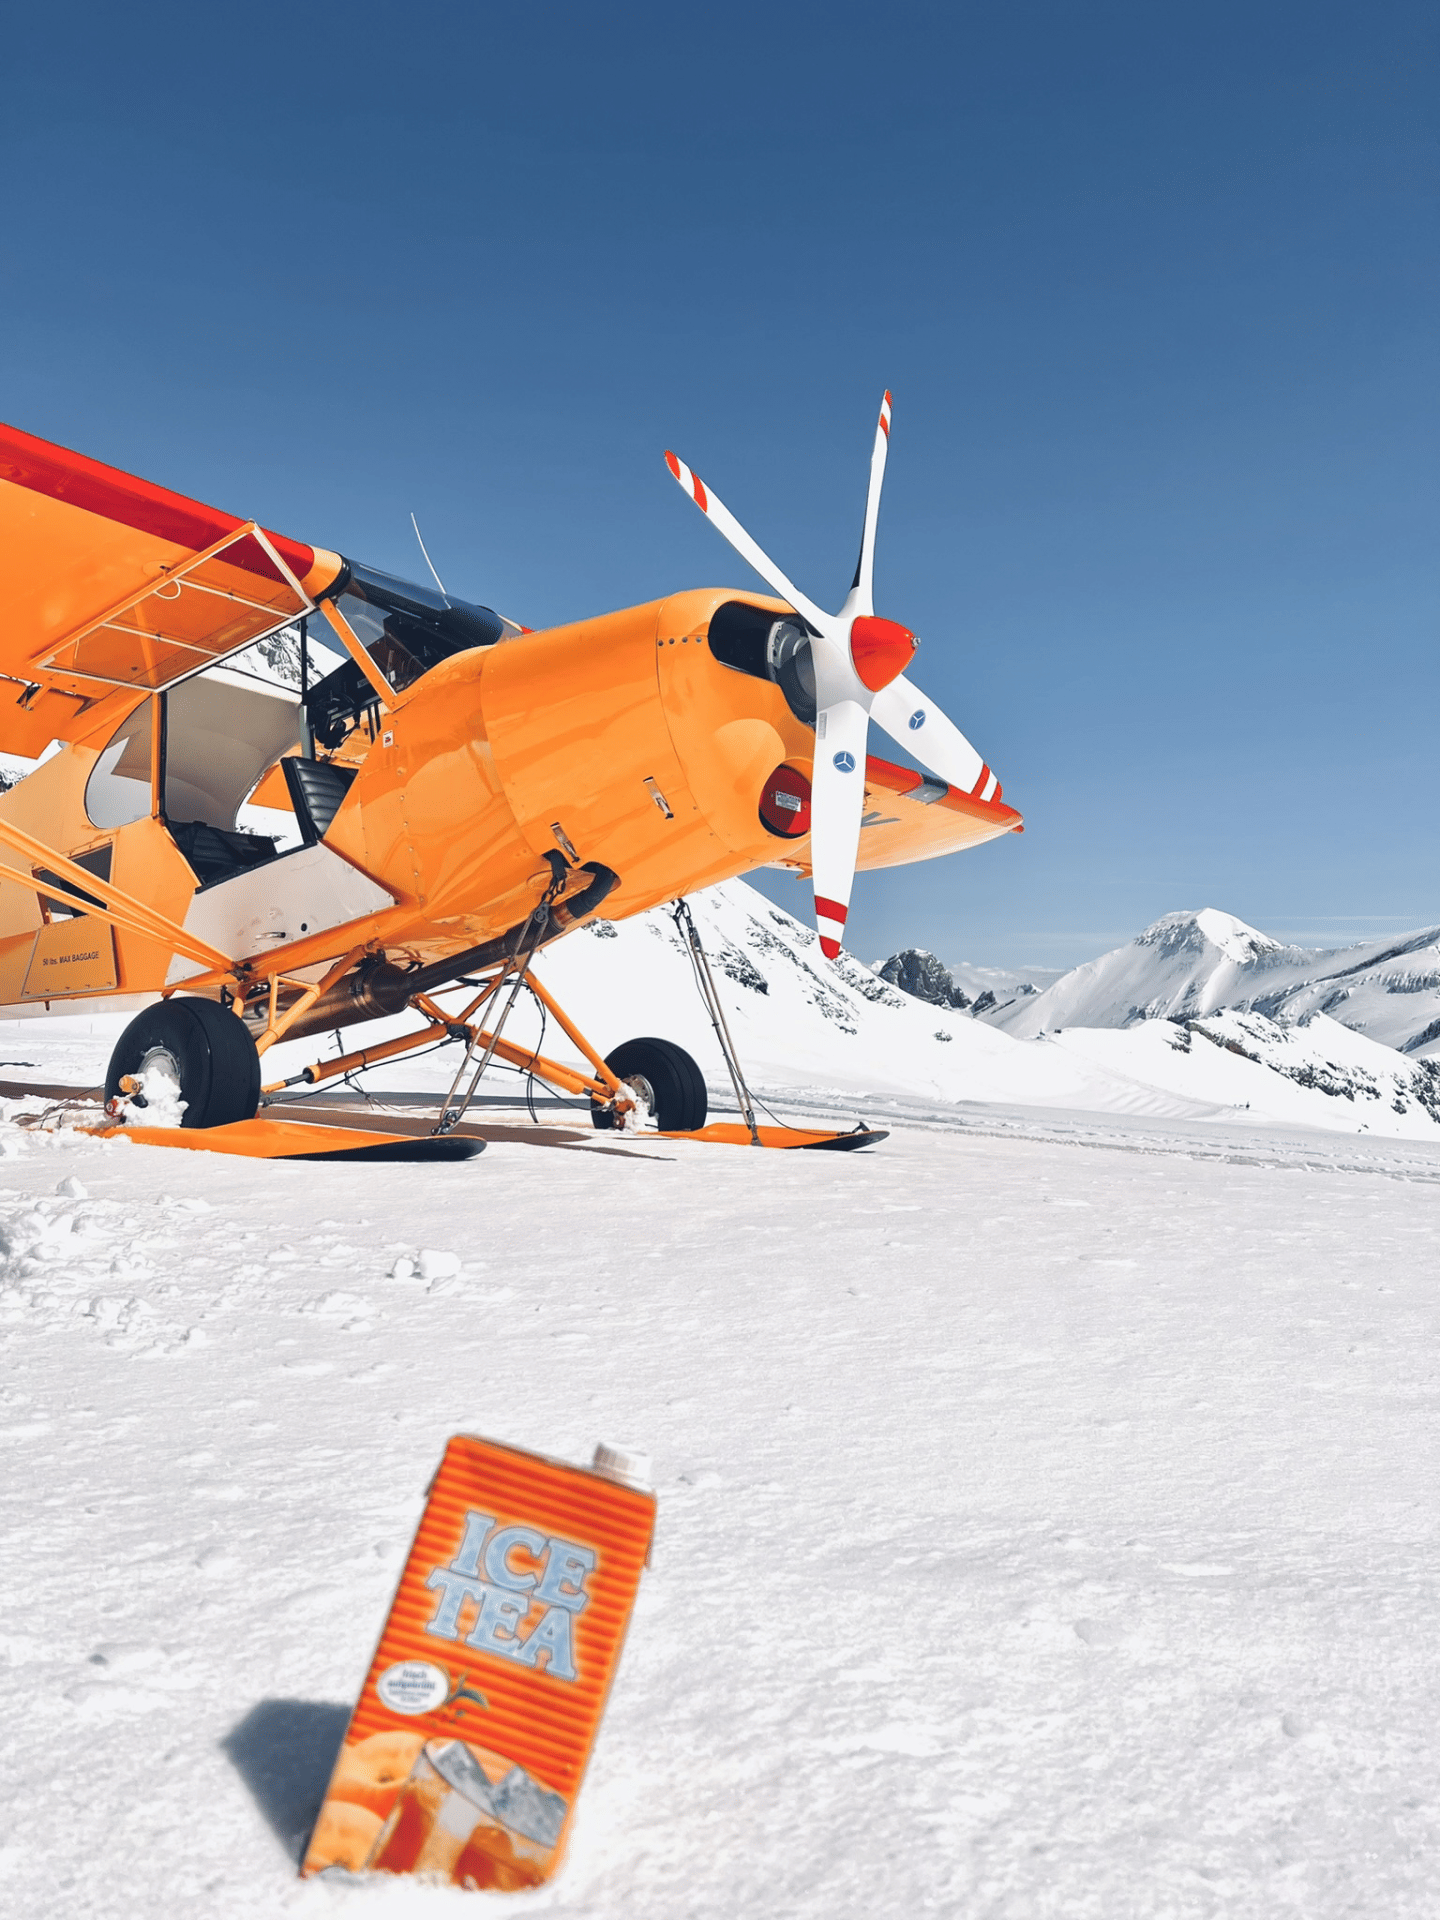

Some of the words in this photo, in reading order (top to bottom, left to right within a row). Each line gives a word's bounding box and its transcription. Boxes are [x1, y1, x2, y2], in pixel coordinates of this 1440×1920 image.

[59, 955, 71, 964] MAX
[72, 951, 99, 962] BAGGAGE
[449, 1510, 595, 1613] ICE
[426, 1567, 577, 1681] TEA
